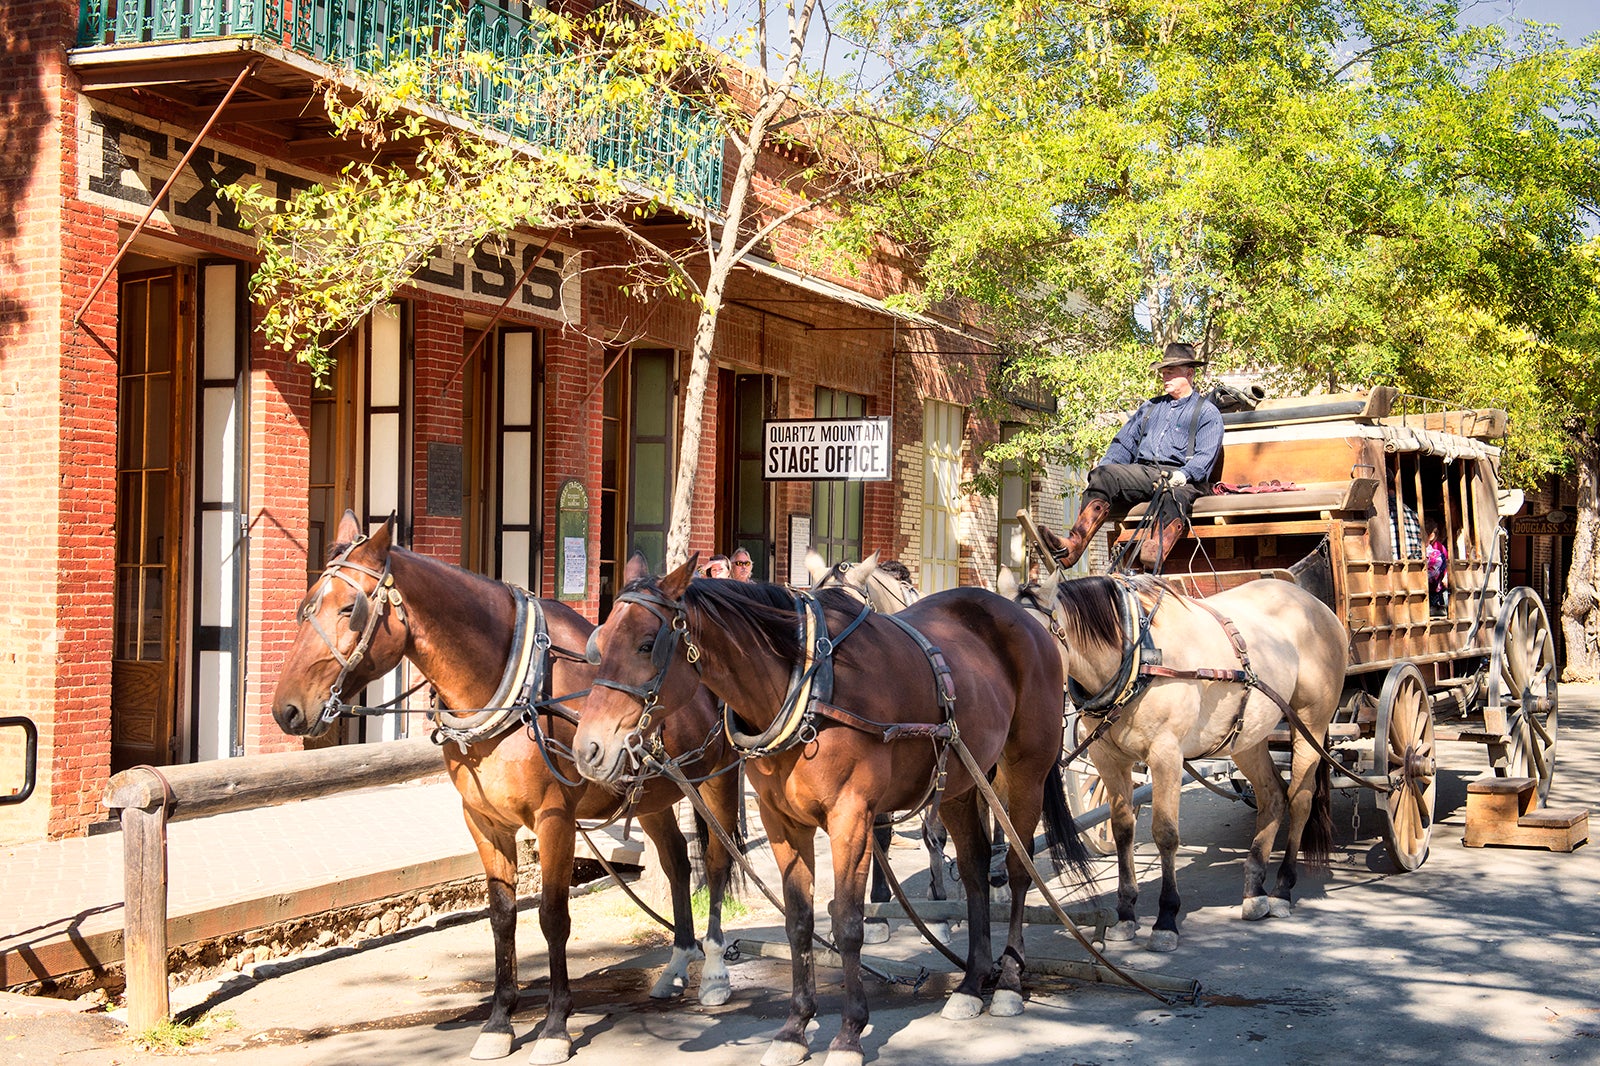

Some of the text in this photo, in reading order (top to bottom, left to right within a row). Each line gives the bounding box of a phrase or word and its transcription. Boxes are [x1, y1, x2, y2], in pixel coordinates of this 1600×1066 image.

[87, 110, 564, 311] EXESS
[770, 425, 883, 443] QUARTZ MOUNTAIN
[769, 446, 884, 473] STAGE OFFICE.
[1515, 522, 1559, 533] DOUGLASS
